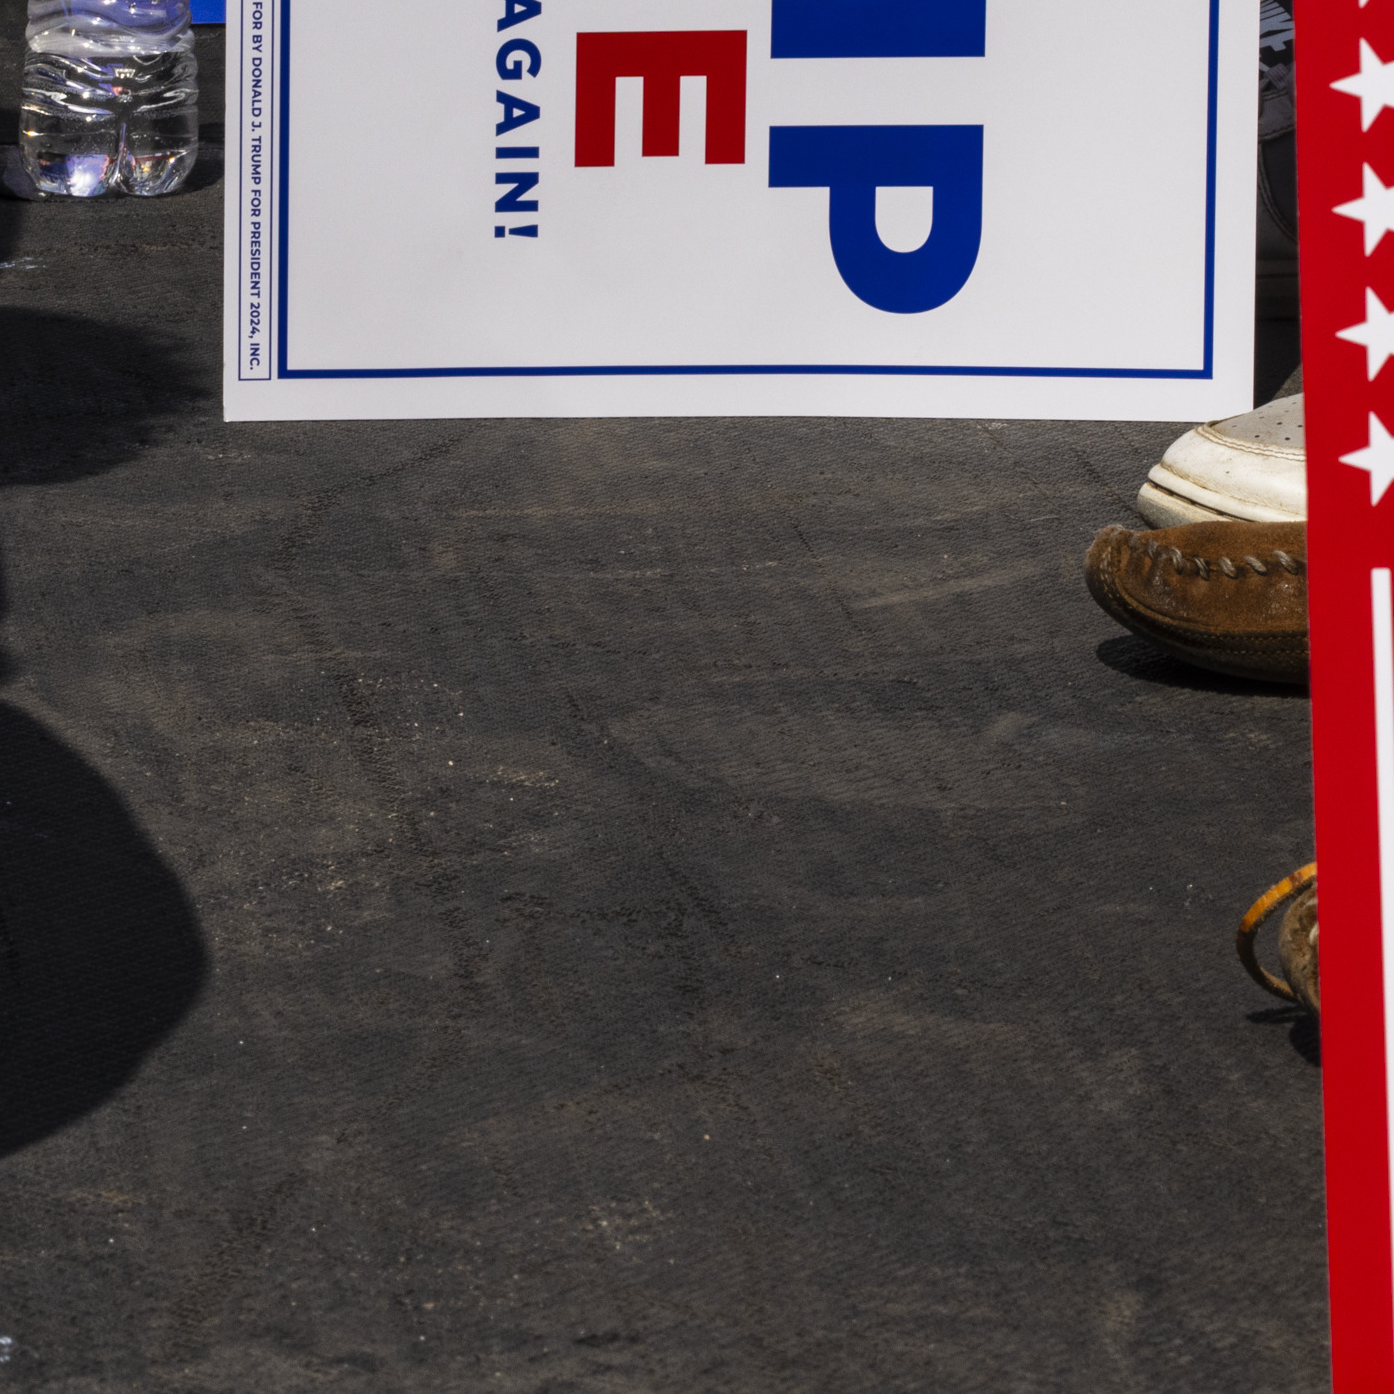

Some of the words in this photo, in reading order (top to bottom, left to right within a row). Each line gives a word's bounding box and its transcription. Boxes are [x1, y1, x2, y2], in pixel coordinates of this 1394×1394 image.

[252, 1, 263, 31] FOR
[252, 34, 263, 53] BY
[252, 56, 263, 118] DONALD
[251, 121, 262, 132] J.
[251, 135, 262, 186] TRUMP
[251, 189, 262, 218] FOR
[250, 221, 262, 299] PRESIDENT
[248, 301, 261, 339] 2024,
[249, 342, 260, 370] INC.
